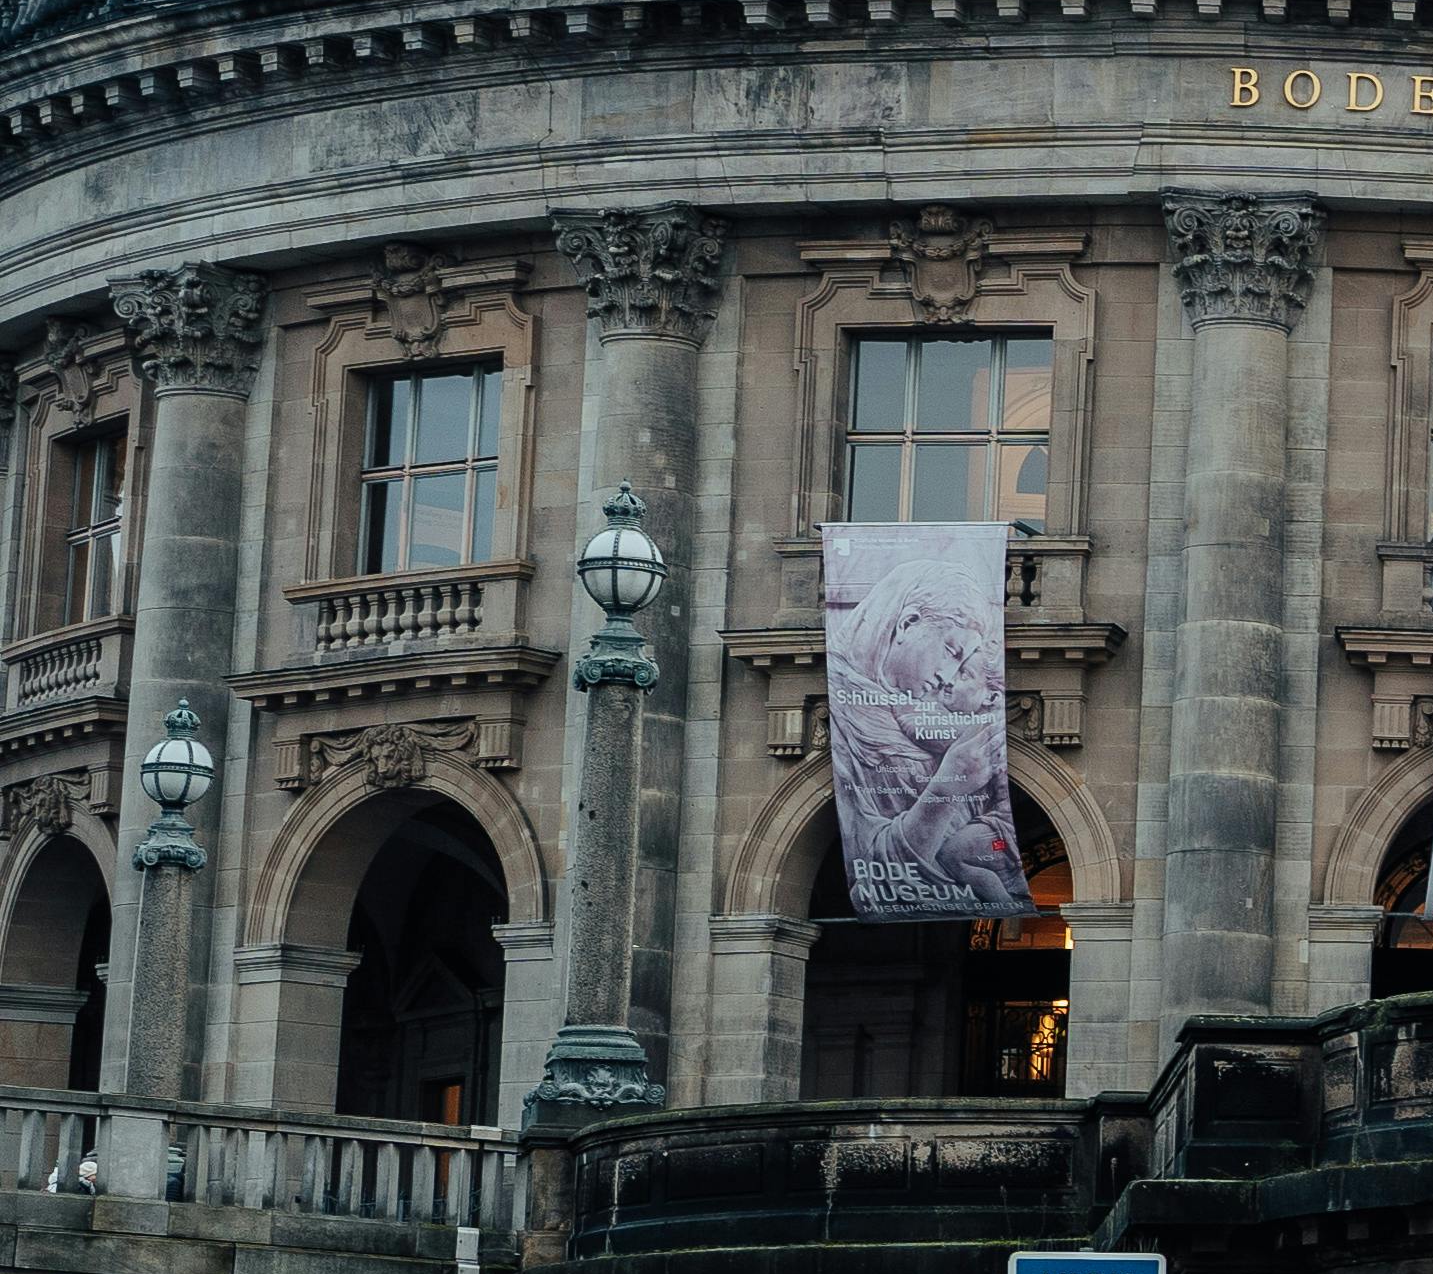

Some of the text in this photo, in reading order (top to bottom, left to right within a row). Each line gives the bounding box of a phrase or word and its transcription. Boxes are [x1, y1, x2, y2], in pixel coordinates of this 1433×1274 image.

[836, 689, 914, 706] Schlüssel
[914, 701, 938, 712] zur
[914, 711, 996, 726] christlichen
[915, 727, 957, 740] Kunst
[853, 858, 921, 882] BODE
[857, 884, 979, 902] MUSEUM
